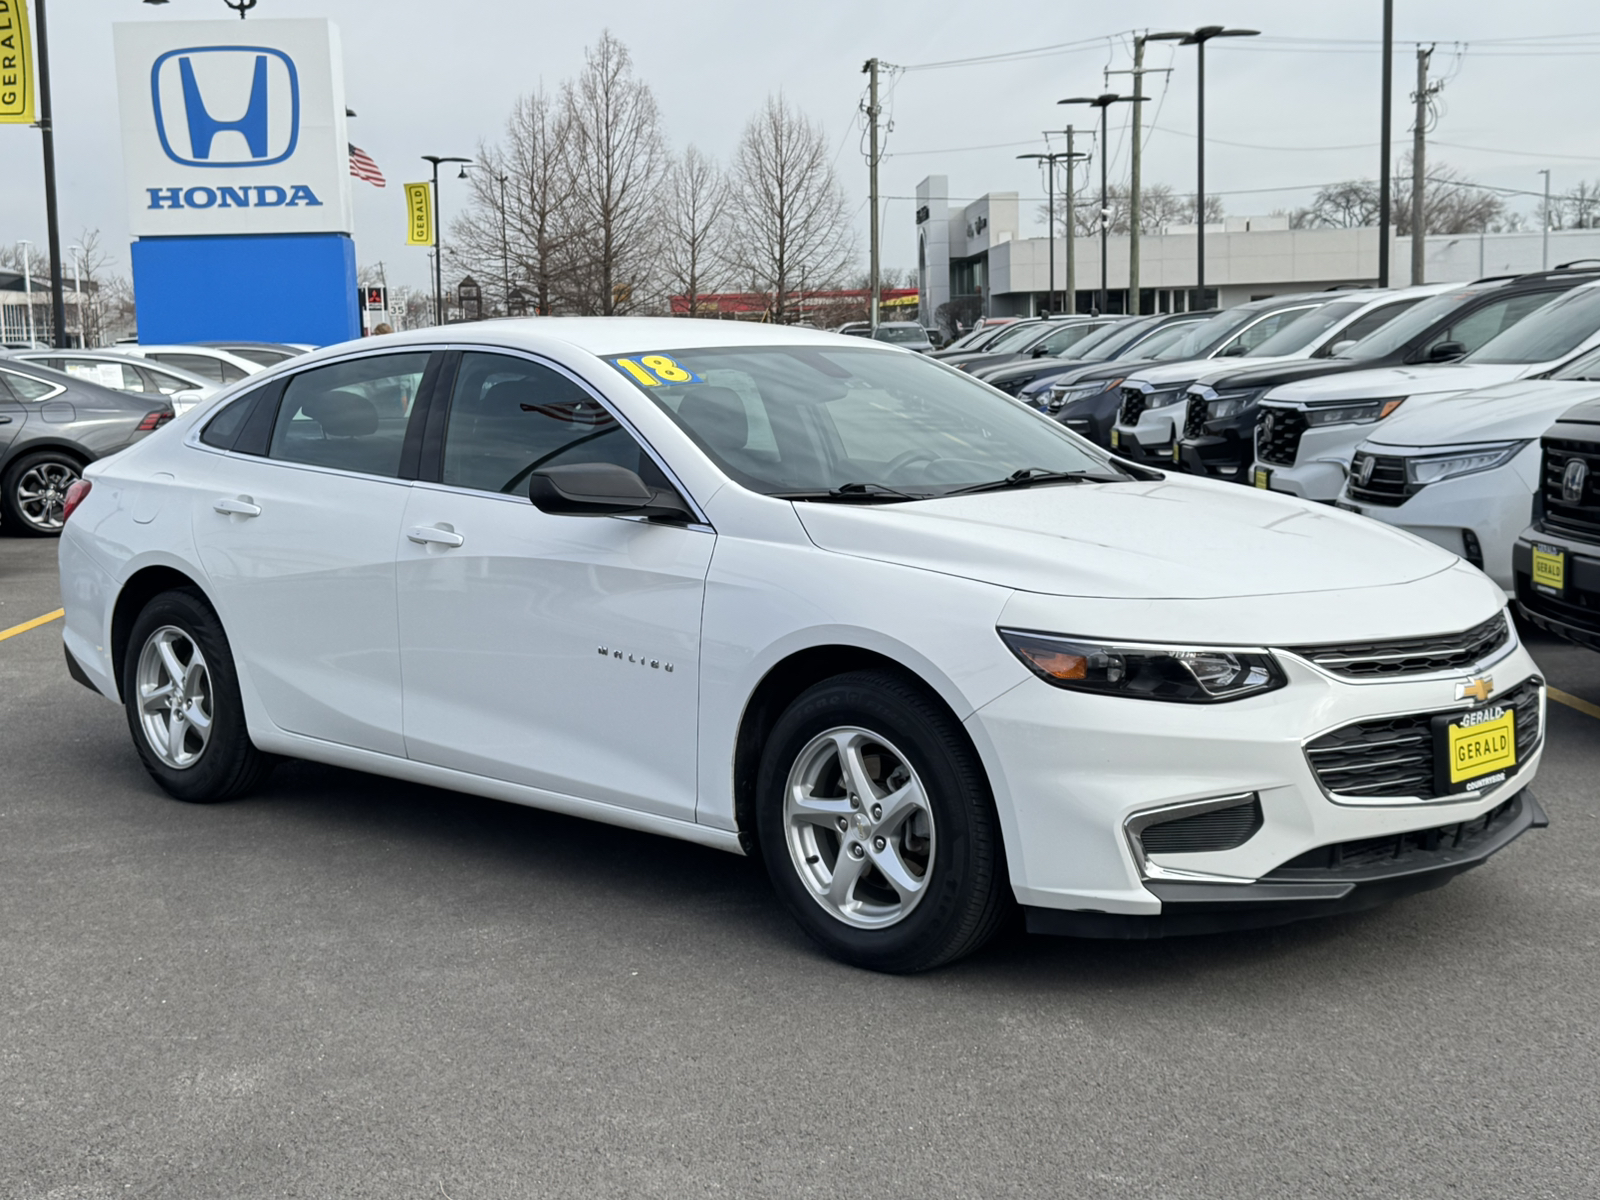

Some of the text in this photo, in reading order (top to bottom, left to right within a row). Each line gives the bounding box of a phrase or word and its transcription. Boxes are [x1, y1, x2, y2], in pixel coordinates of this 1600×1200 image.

[146, 184, 324, 210] HONDA
[414, 190, 425, 238] GERALD
[390, 306, 404, 315] 35
[616, 354, 693, 388] 18
[597, 645, 675, 673] MALIBU
[1457, 734, 1507, 762] GERALD
